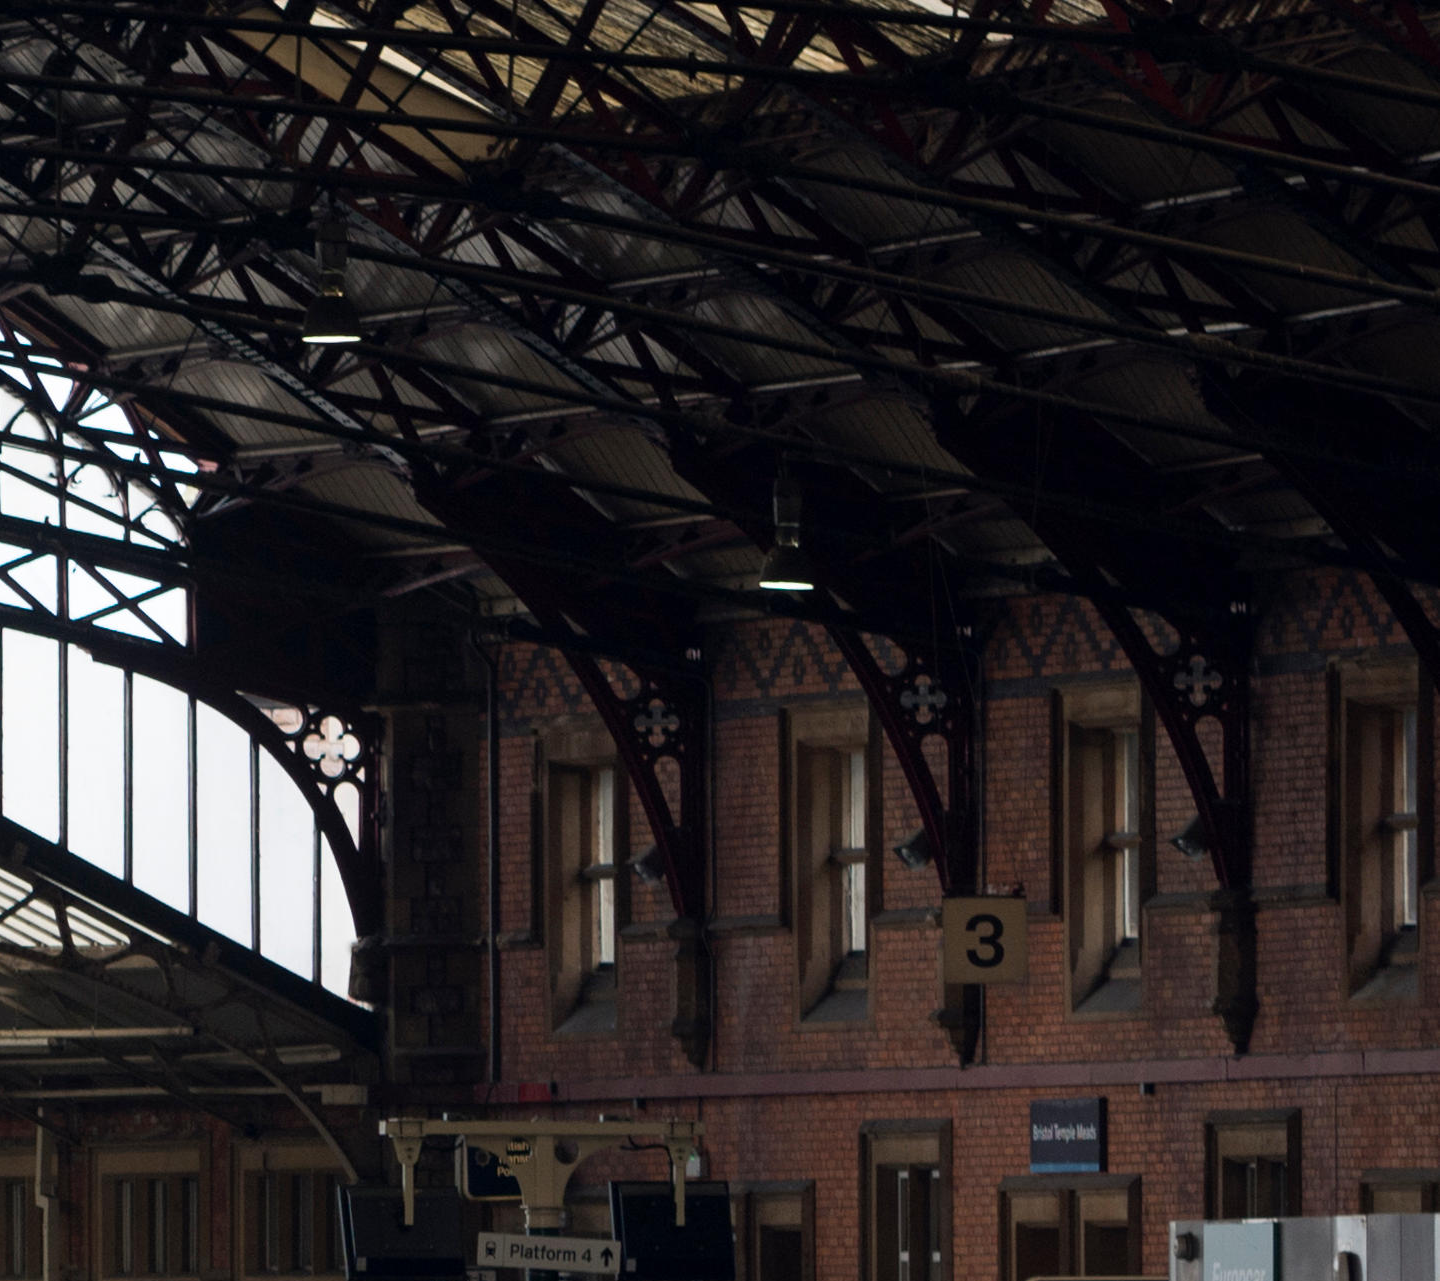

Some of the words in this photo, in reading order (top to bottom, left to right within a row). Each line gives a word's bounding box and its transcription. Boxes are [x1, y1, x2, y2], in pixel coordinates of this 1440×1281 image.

[965, 913, 1005, 969] 3
[1033, 1123, 1054, 1140] Bristol
[1054, 1124, 1077, 1143] Temple
[1077, 1125, 1097, 1141] Meads
[509, 1242, 578, 1264] Platform
[580, 1246, 593, 1264] 4
